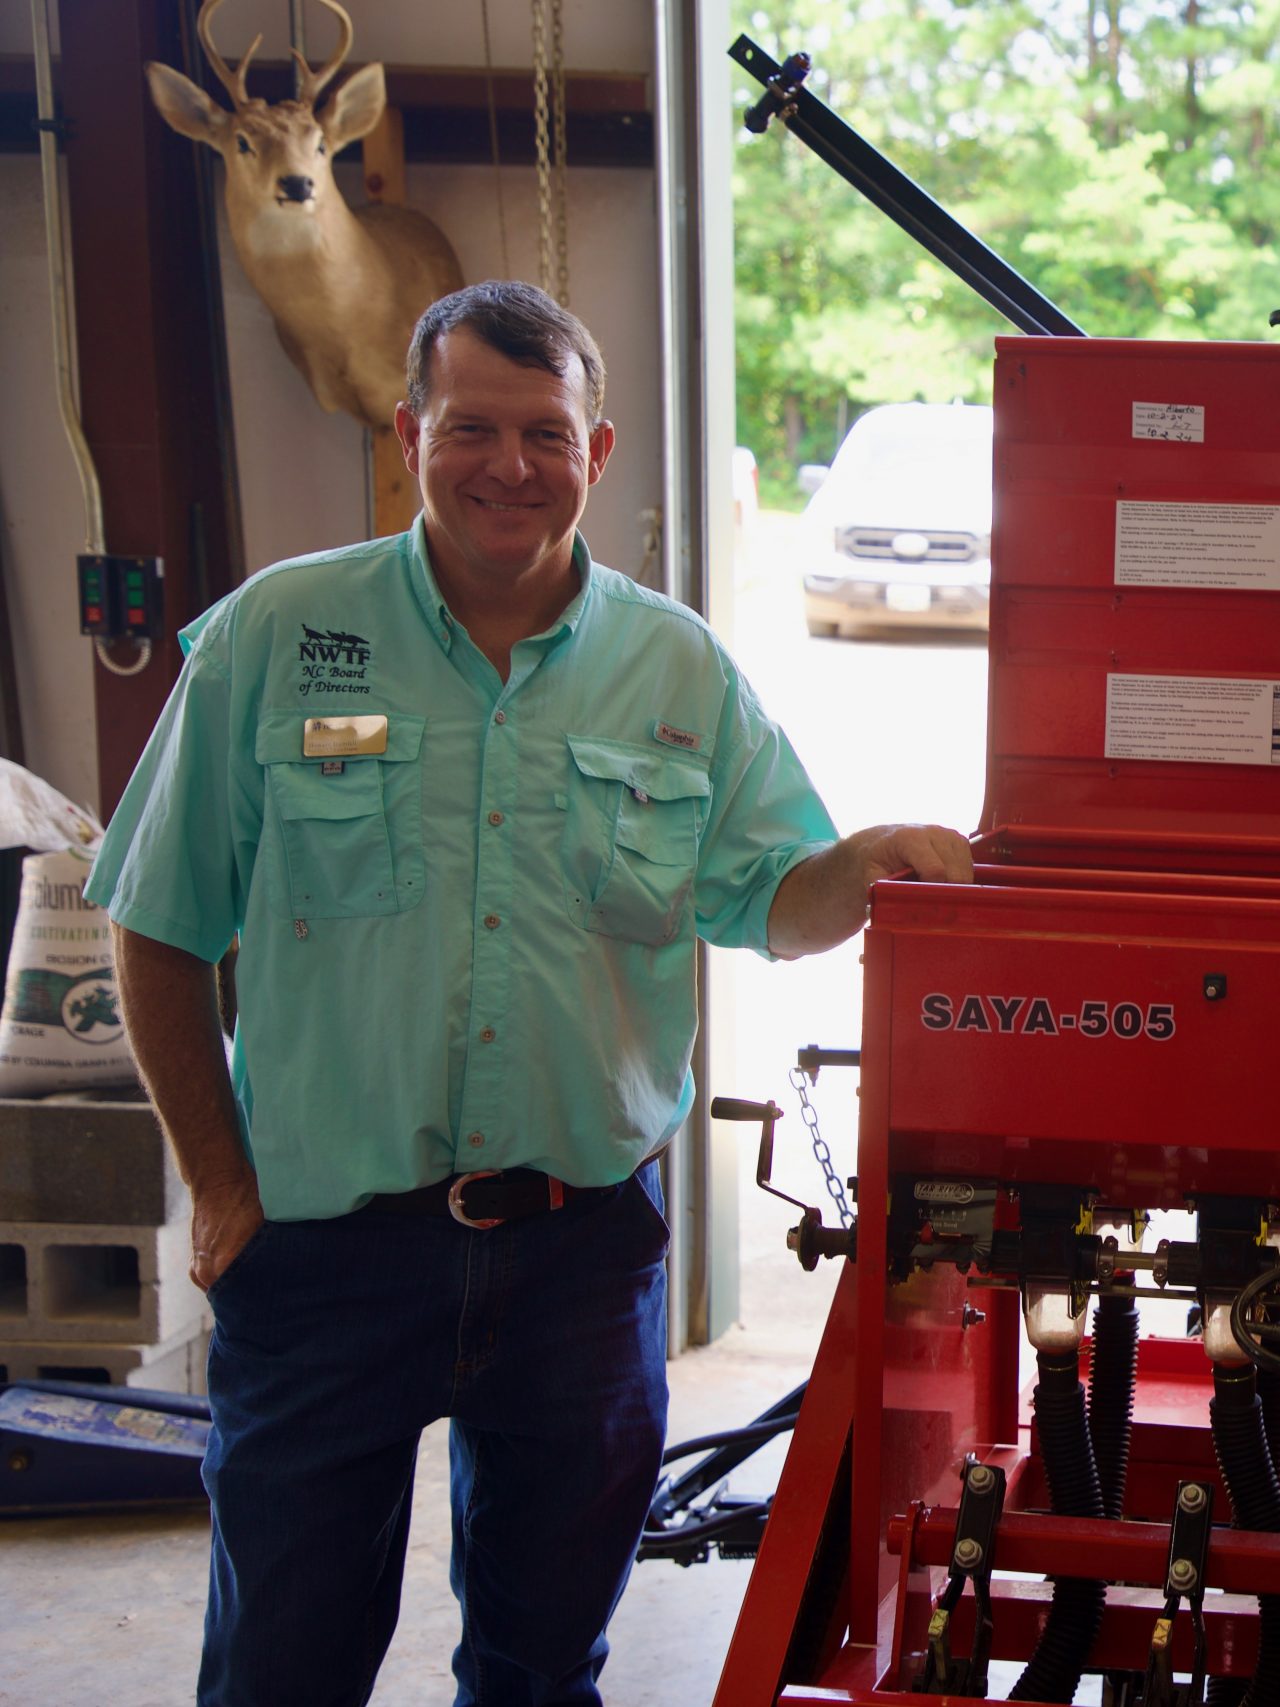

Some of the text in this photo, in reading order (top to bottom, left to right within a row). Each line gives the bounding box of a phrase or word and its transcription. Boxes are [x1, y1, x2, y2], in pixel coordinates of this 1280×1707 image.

[298, 644, 371, 665] NWTF
[302, 664, 367, 679] NC Board
[300, 681, 371, 696] of Directors
[920, 992, 1176, 1041] SAYA-505
